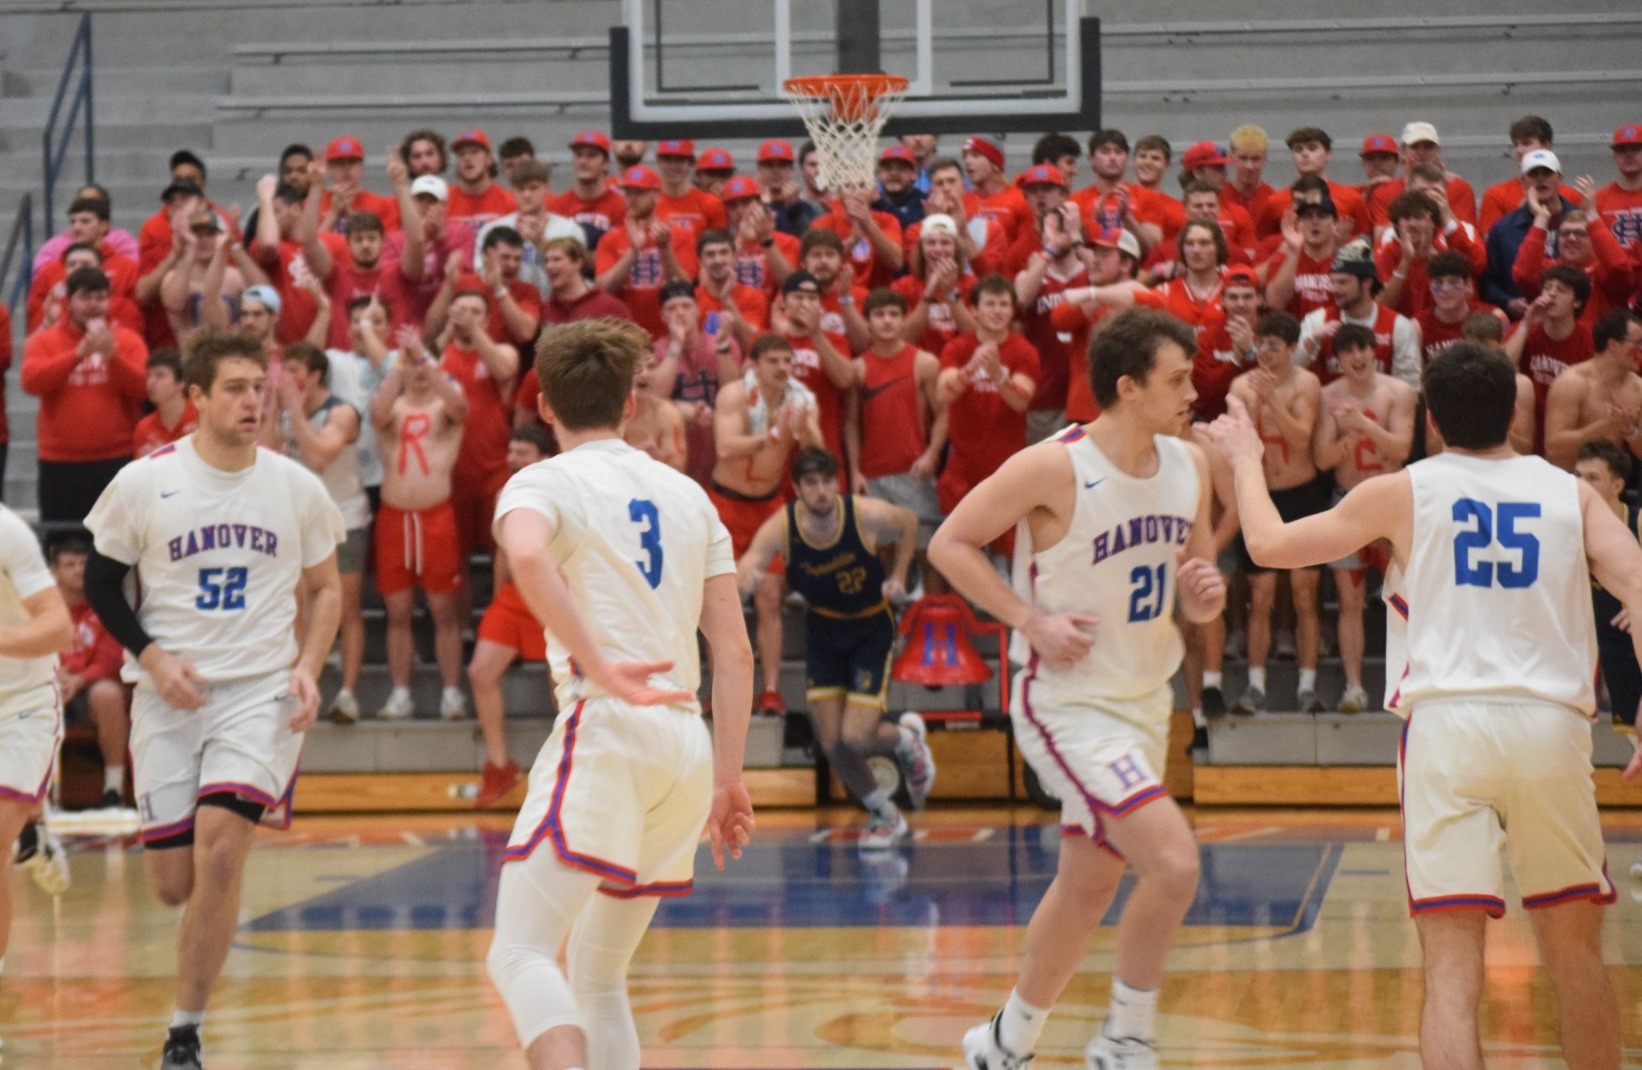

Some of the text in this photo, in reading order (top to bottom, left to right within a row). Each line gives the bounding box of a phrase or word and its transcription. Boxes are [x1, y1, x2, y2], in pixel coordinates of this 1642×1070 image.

[398, 413, 430, 476] R
[168, 523, 278, 562] HANOVER
[628, 497, 663, 590] 3
[1092, 514, 1193, 566] HANOVE
[1452, 497, 1541, 589] 25
[195, 566, 248, 611] 52
[1127, 562, 1167, 623] 21
[923, 623, 957, 667] H
[1106, 752, 1149, 793] H
